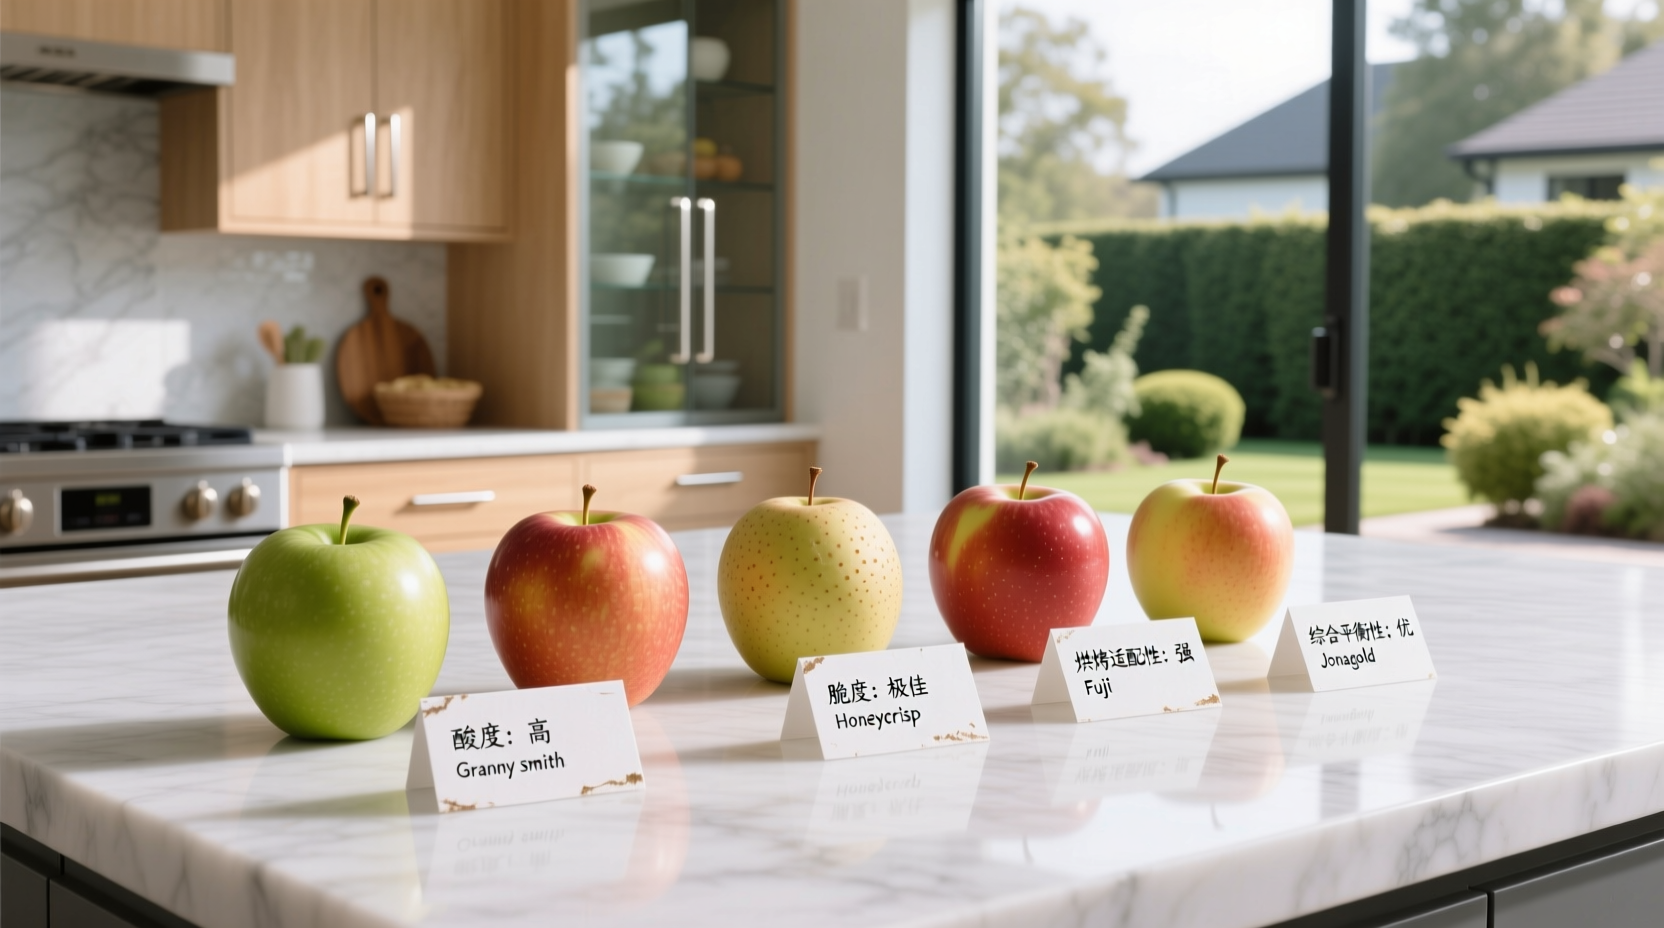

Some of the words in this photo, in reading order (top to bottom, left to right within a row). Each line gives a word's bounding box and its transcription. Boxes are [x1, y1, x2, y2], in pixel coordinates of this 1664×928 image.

[1320, 646, 1376, 671] Jonagold
[827, 674, 929, 705] 脆度：极佳
[1084, 677, 1113, 699] Fuji
[835, 706, 921, 731] Honeycrisp
[451, 717, 551, 751] 酸度：高
[456, 761, 515, 780] Granny
[520, 751, 565, 773] smith
